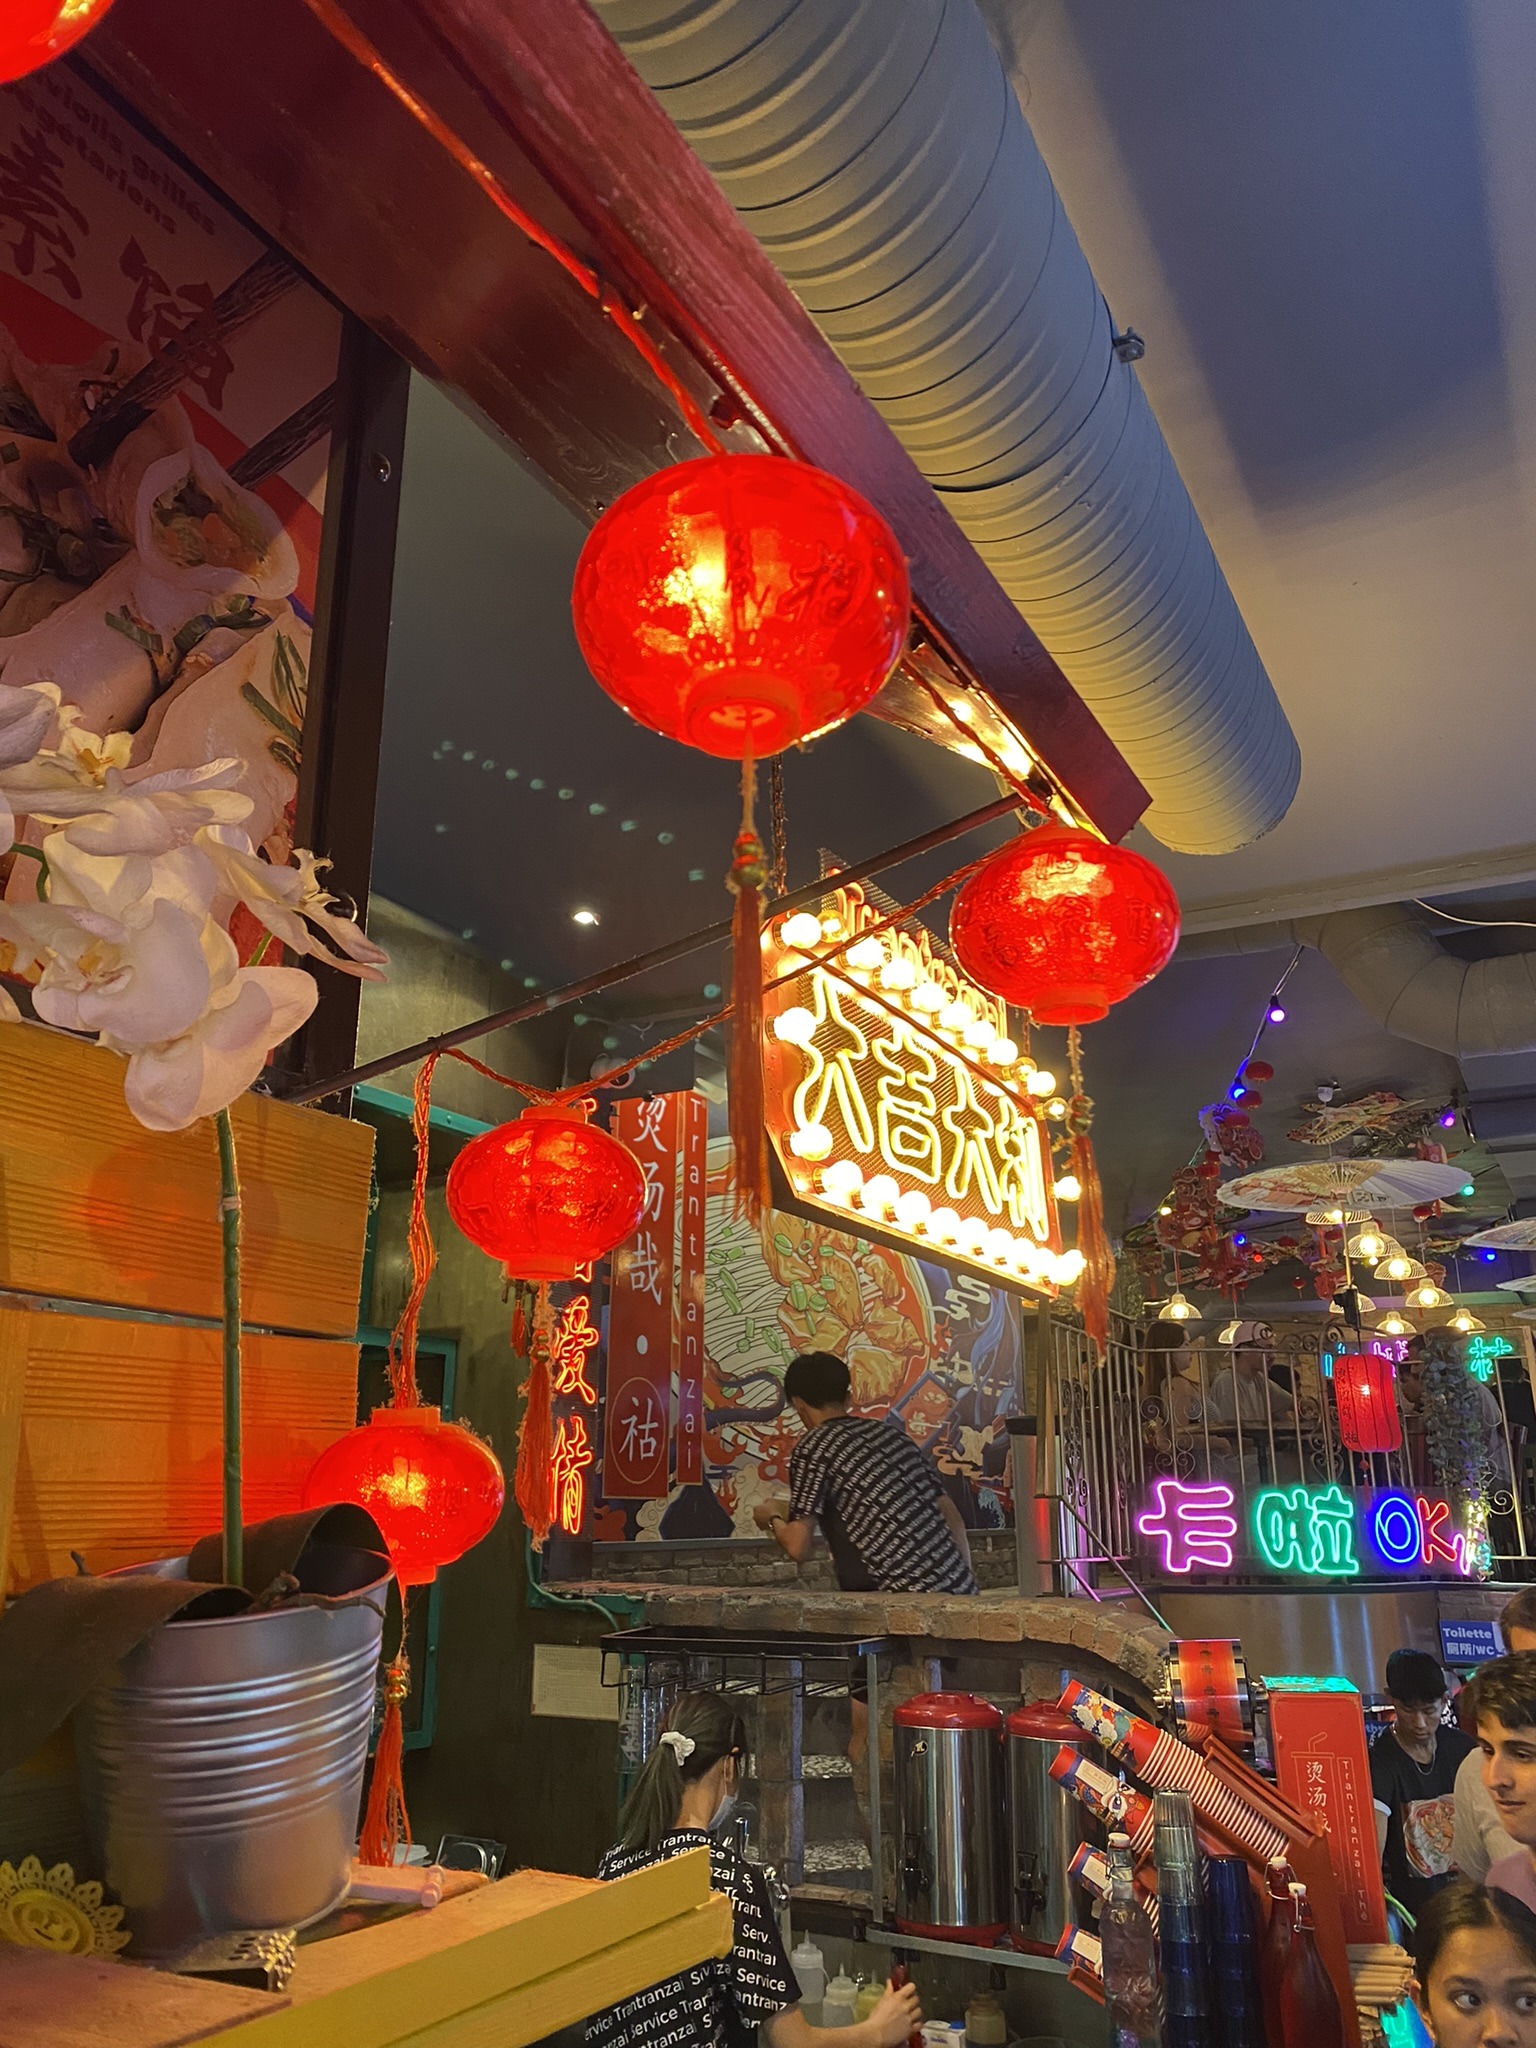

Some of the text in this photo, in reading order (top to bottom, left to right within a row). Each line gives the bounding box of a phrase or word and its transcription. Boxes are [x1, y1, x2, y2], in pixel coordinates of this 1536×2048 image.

[684, 1096, 702, 1469] Trantranzai
[1442, 1626, 1493, 1640] Toilette
[612, 1974, 686, 2022] Trantranzai
[736, 1967, 787, 1993] Service
